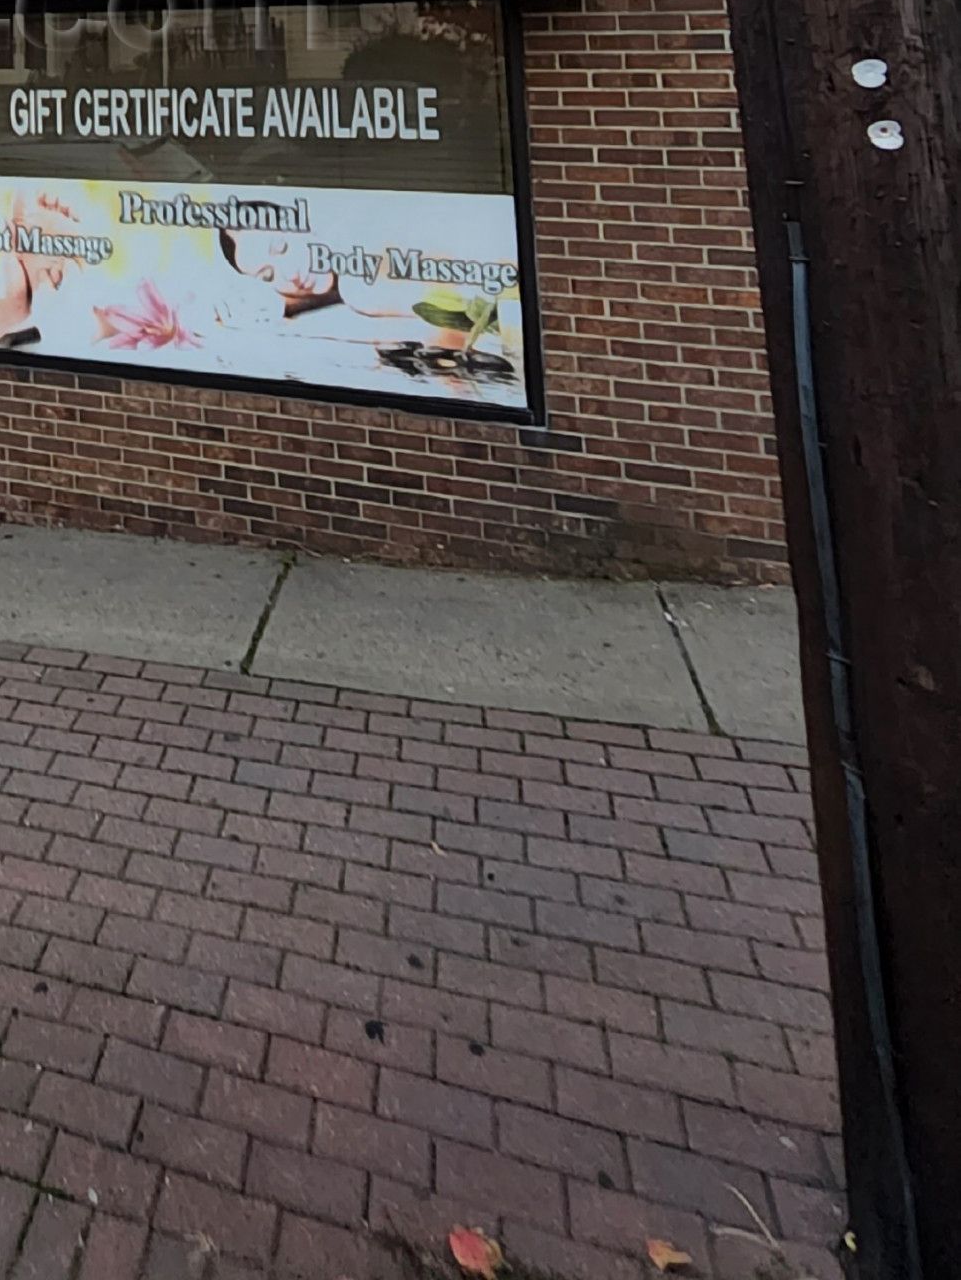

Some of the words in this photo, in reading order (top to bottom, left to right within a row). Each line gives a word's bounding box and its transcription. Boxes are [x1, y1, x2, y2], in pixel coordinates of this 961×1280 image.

[10, 88, 66, 136] GIFT
[74, 87, 255, 137] CERTIFICATE
[262, 87, 440, 140] AVAILABLE
[119, 191, 311, 233] Professional
[15, 227, 113, 261] Massage
[308, 242, 383, 281] Body
[388, 248, 519, 294] Massage
